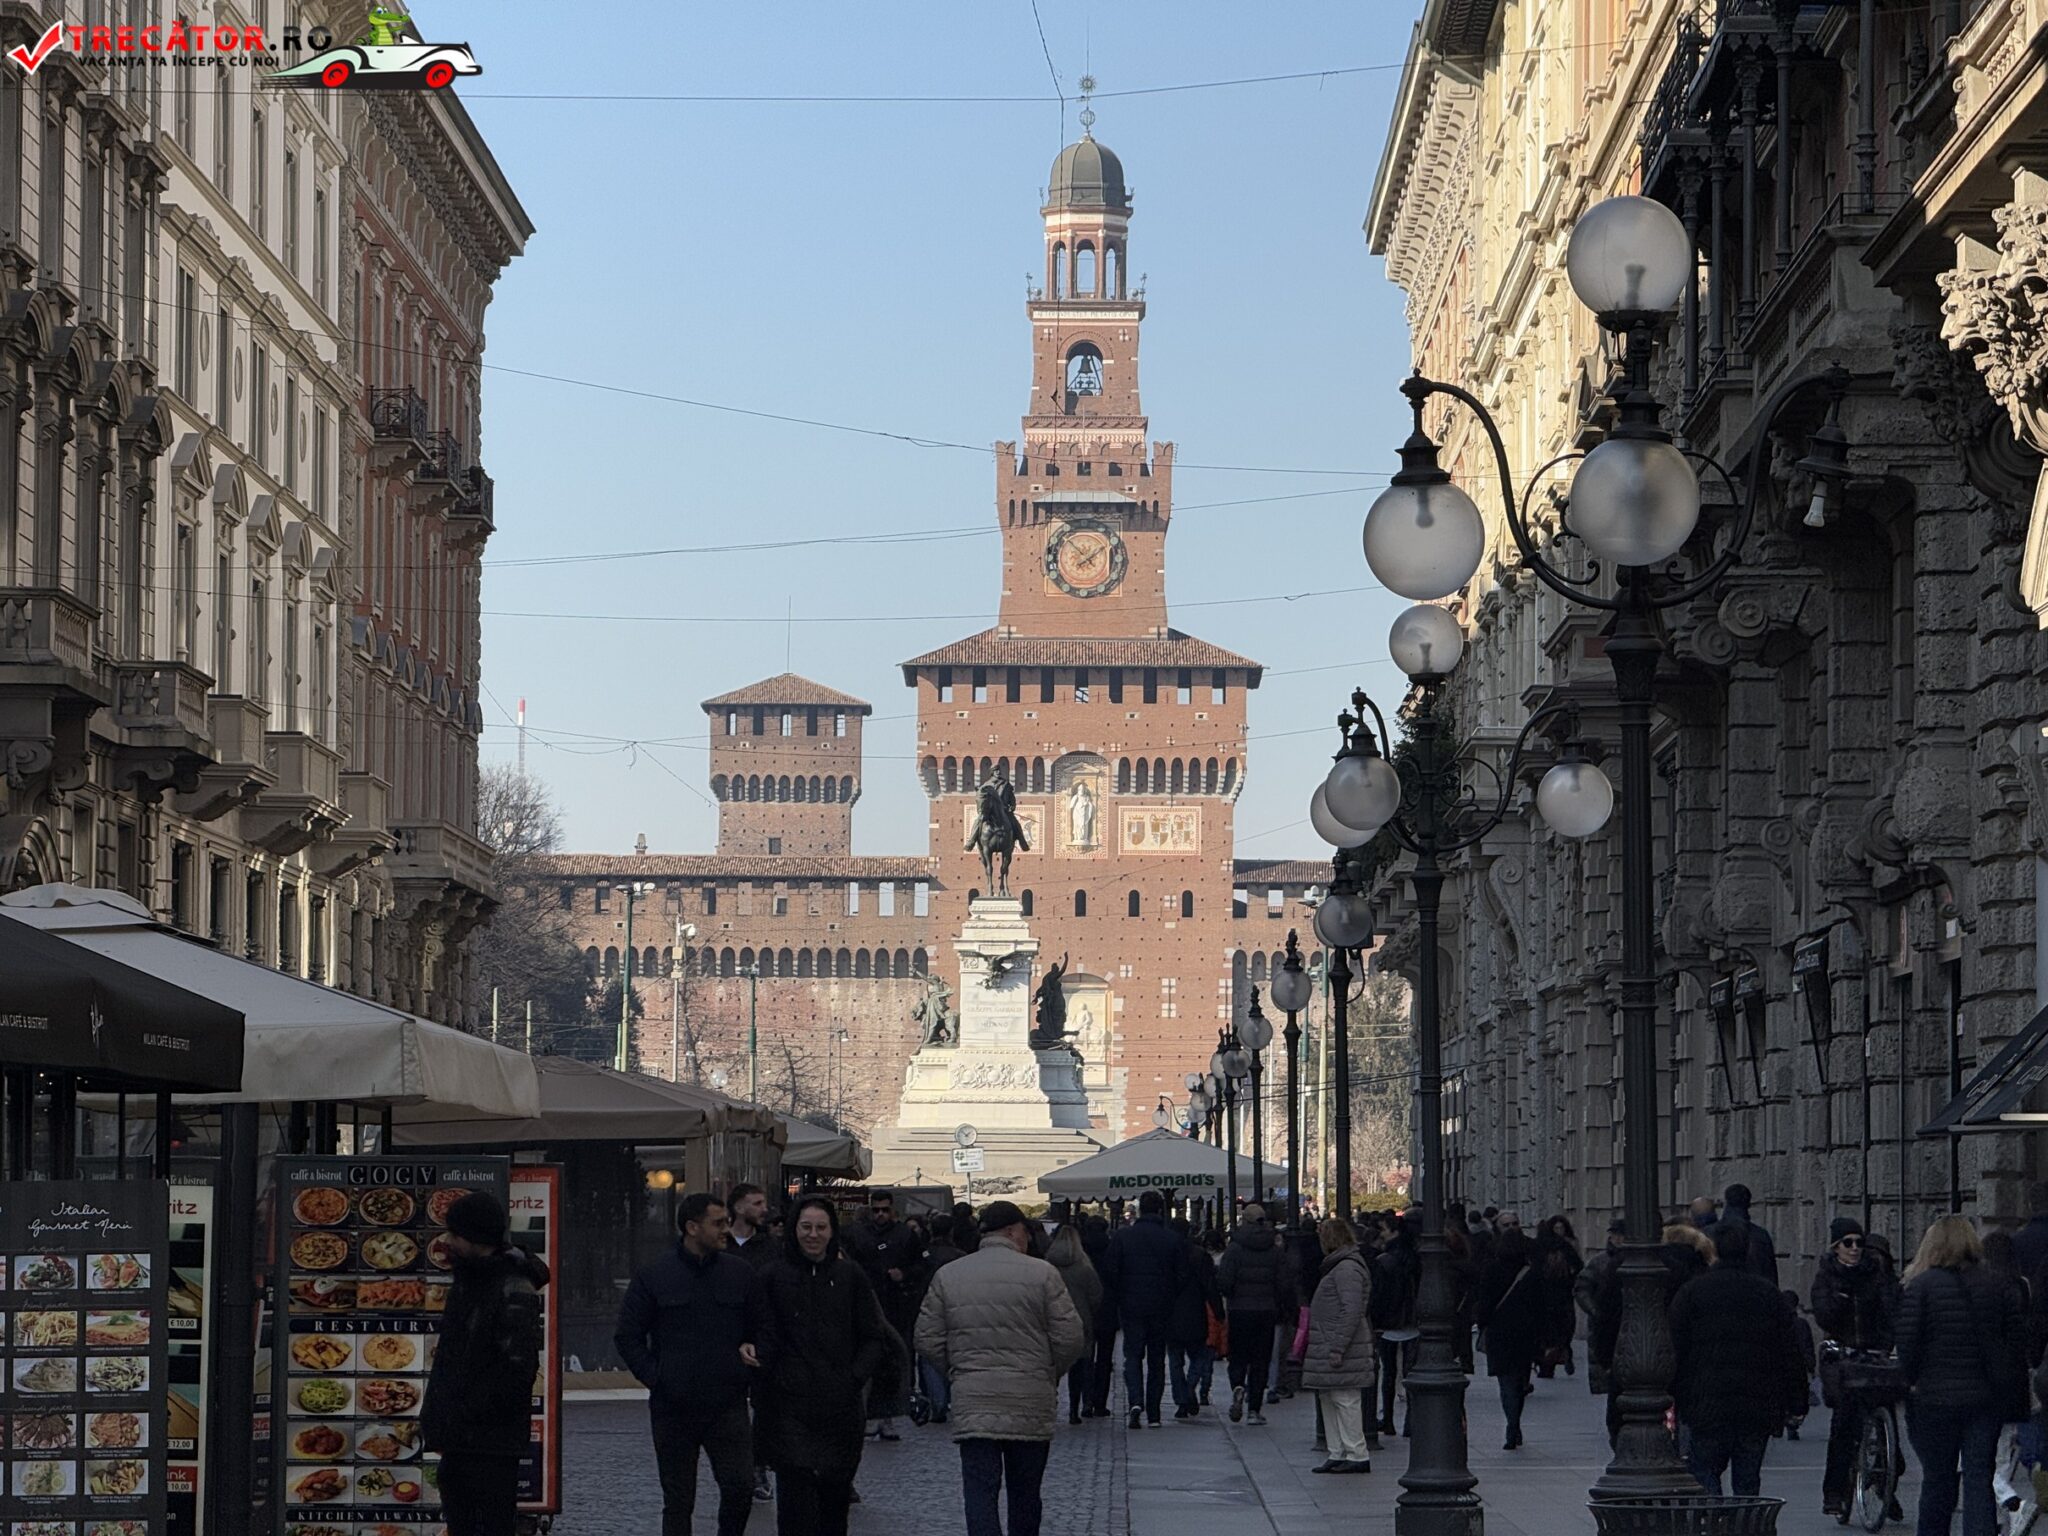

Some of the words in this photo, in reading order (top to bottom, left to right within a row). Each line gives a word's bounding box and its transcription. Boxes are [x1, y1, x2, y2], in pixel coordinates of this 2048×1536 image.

[316, 1168, 342, 1181] bistrot
[468, 1168, 494, 1182] bistrot
[1109, 1173, 1215, 1189] McDonald's
[51, 1202, 110, 1216] Italian
[28, 1219, 91, 1238] Gourmet
[314, 1320, 435, 1332] RESTAURA
[167, 1468, 186, 1480] ink
